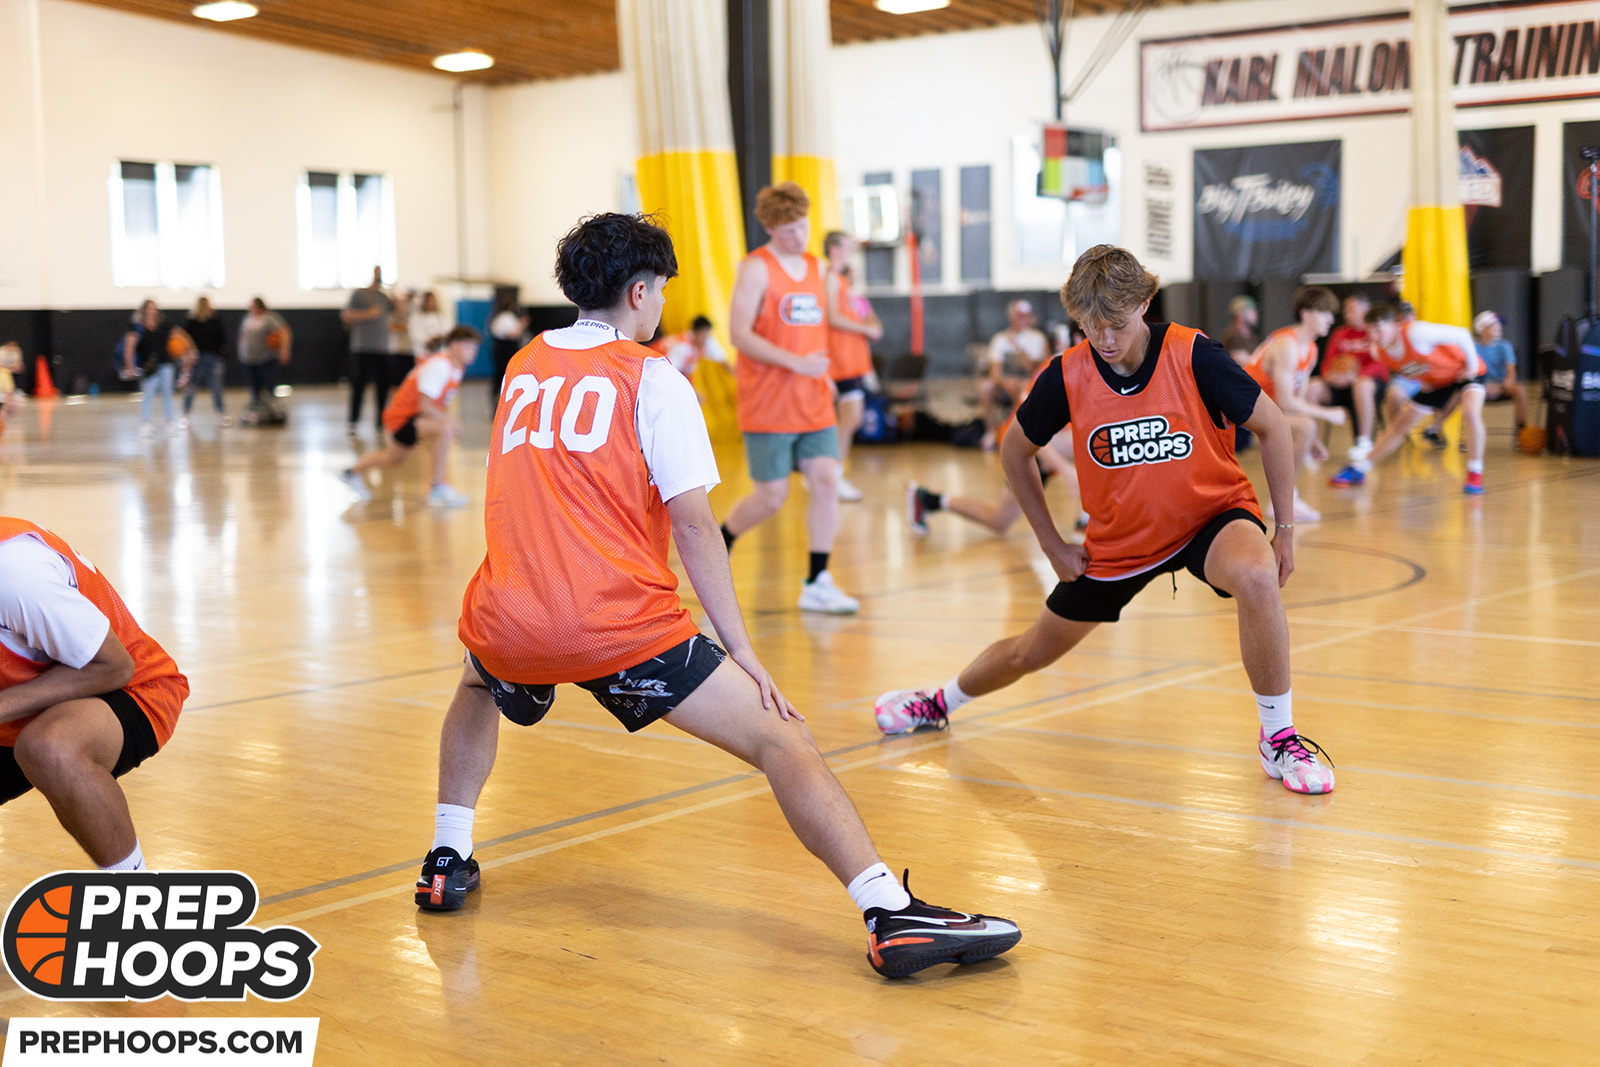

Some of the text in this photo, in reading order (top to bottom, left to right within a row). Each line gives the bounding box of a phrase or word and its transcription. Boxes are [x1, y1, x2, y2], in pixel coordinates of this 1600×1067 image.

[1202, 21, 1600, 106] KARL MALON TRAININ
[590, 321, 610, 331] PRO
[502, 373, 618, 455] 210
[1110, 420, 1165, 445] PREP
[1112, 436, 1188, 464] HOOPS
[436, 856, 453, 867] GT
